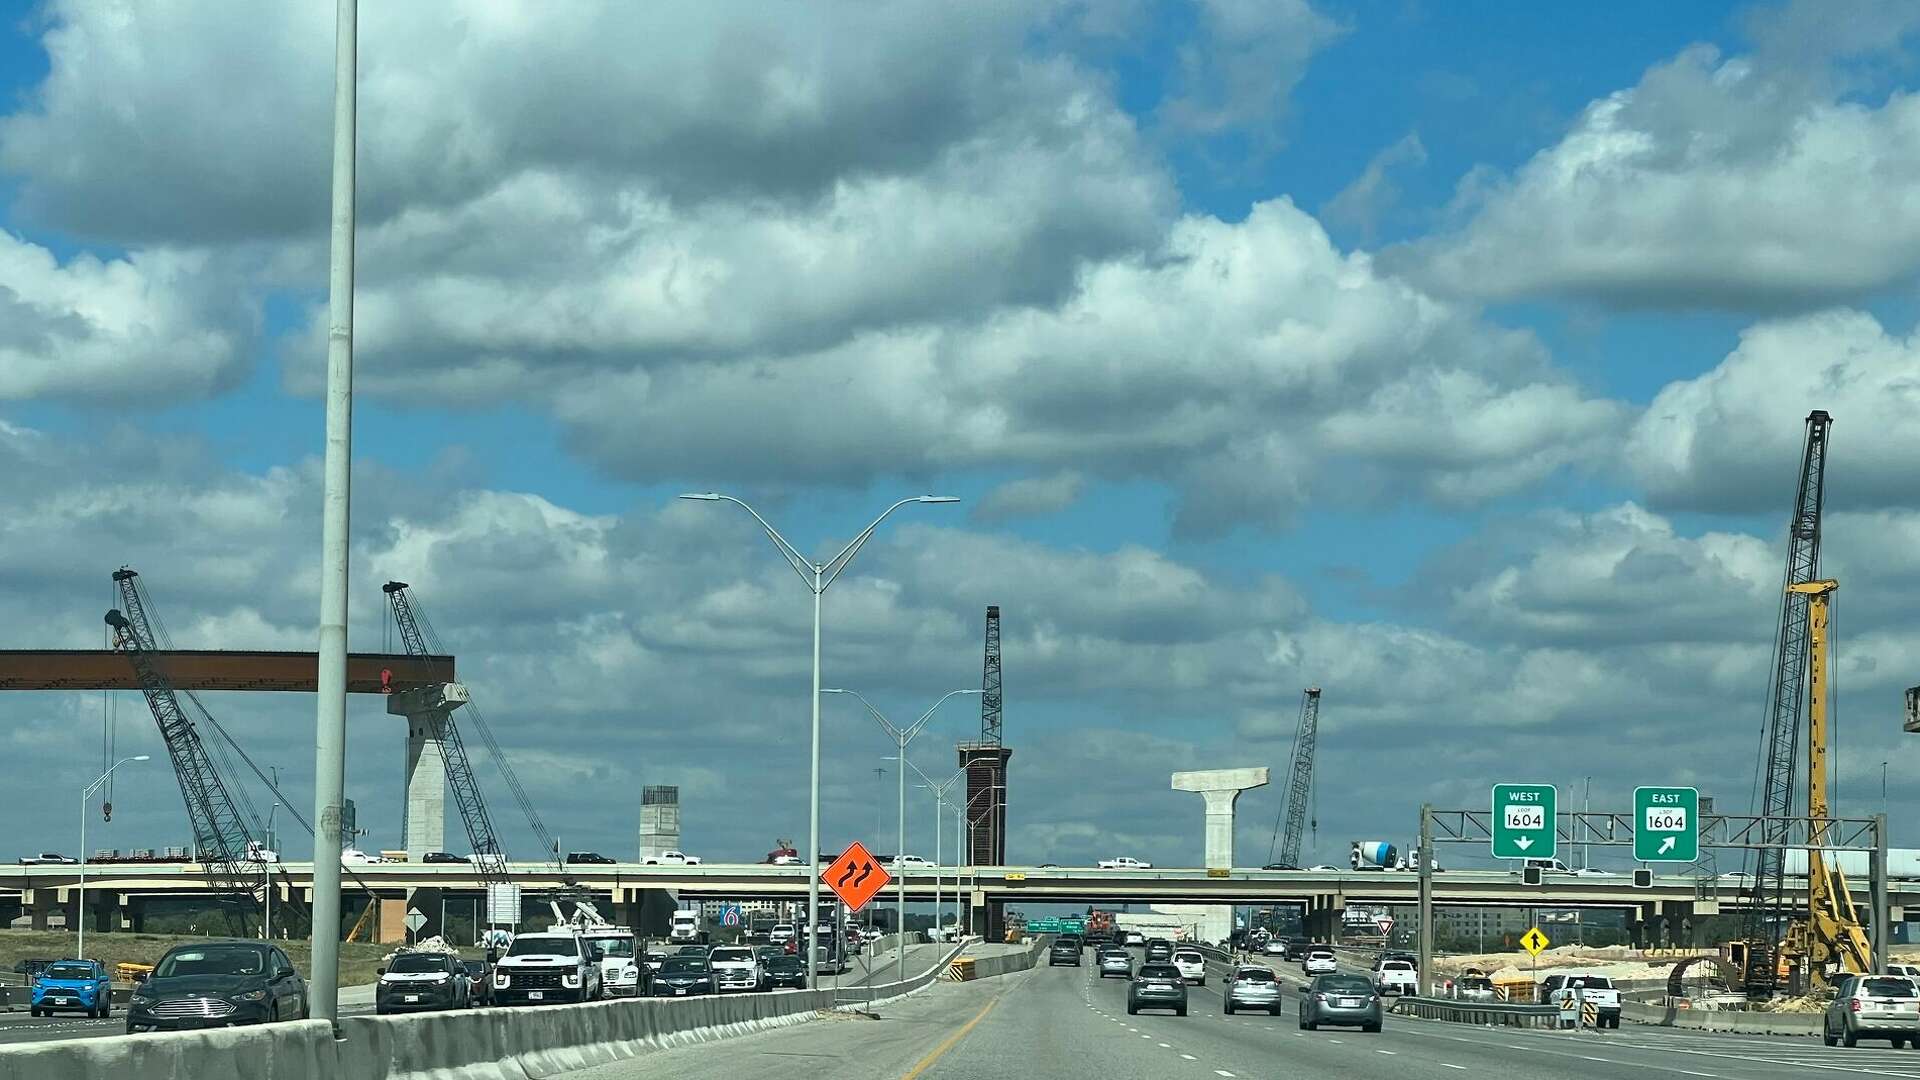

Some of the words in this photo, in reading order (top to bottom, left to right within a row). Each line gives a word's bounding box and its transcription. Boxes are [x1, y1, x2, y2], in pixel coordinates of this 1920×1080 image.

[1509, 791, 1541, 802] WEST
[1652, 793, 1681, 803] EAST
[1507, 813, 1541, 827] 1604
[1648, 815, 1683, 829] 1604
[723, 906, 739, 928] 6
